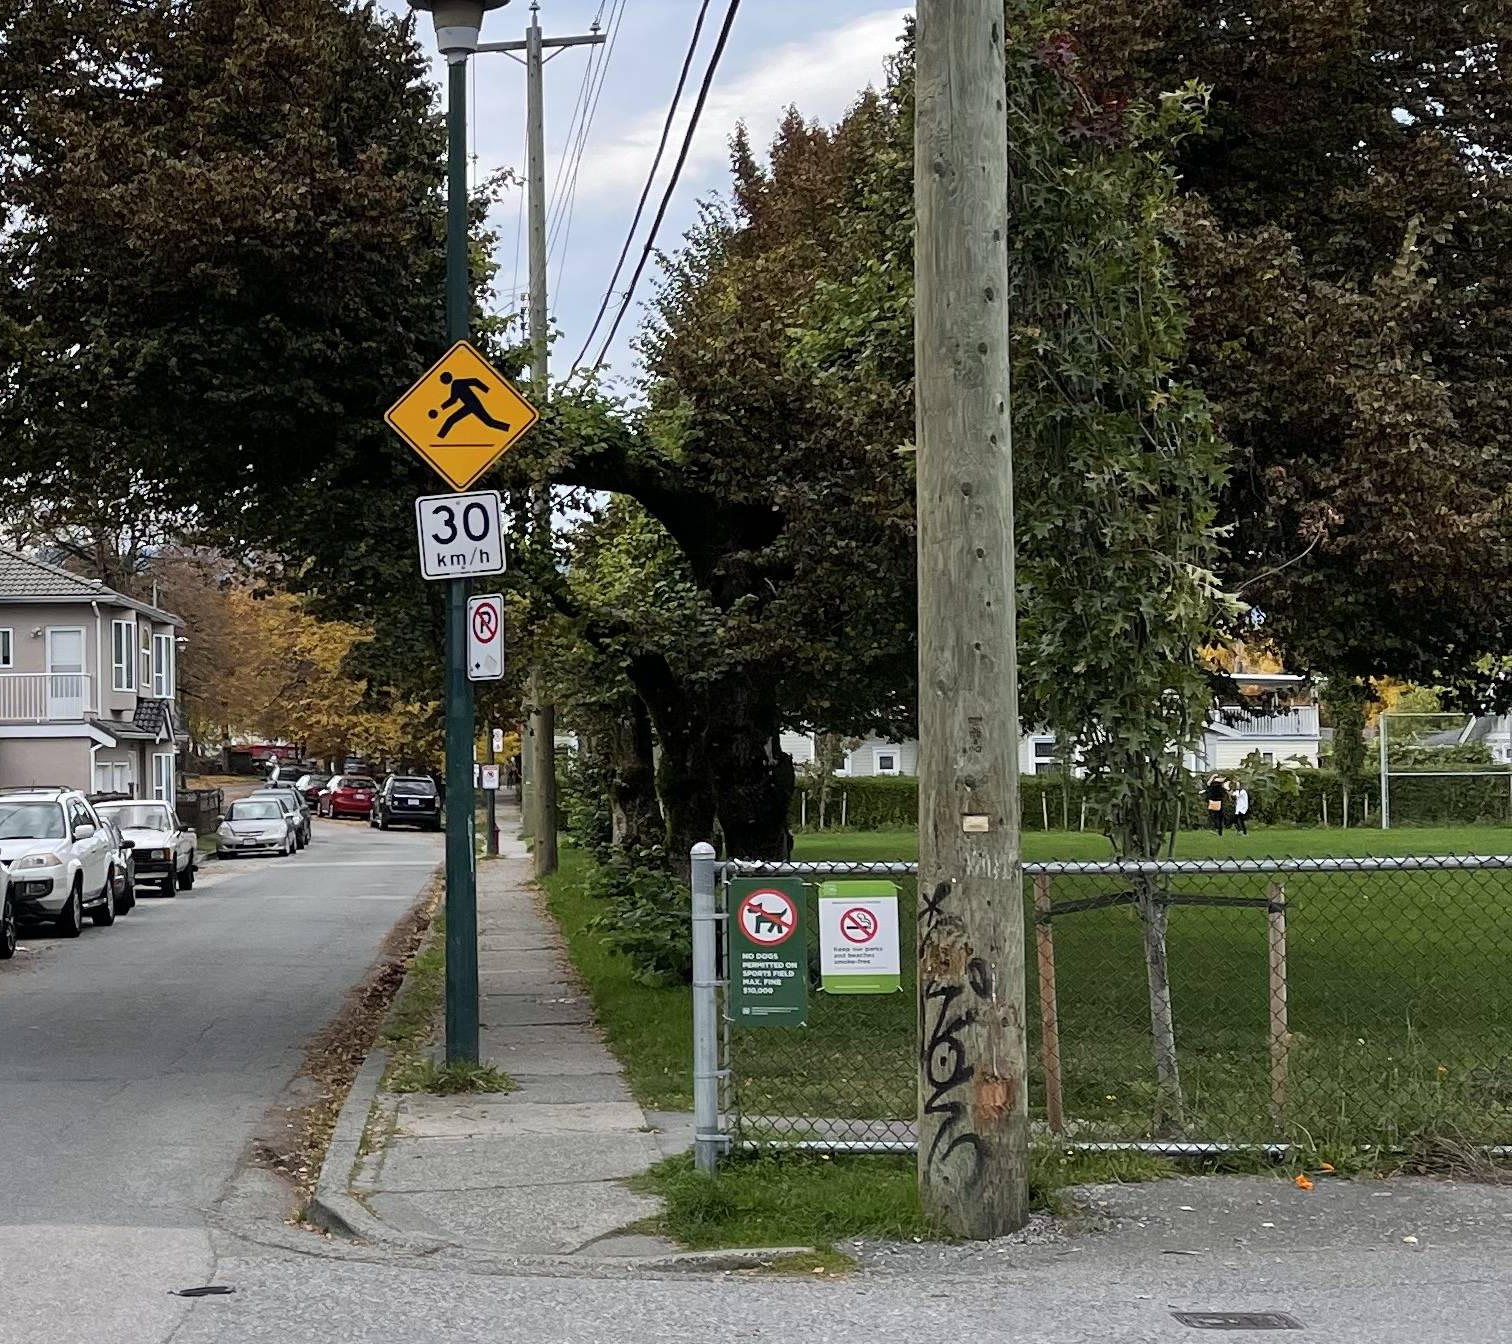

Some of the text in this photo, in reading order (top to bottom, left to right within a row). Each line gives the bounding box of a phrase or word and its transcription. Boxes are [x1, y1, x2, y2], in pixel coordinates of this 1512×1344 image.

[432, 502, 490, 545] 30
[437, 546, 490, 568] km/h
[741, 952, 779, 960] NO DOGS
[742, 961, 798, 969] PERMITTED ON
